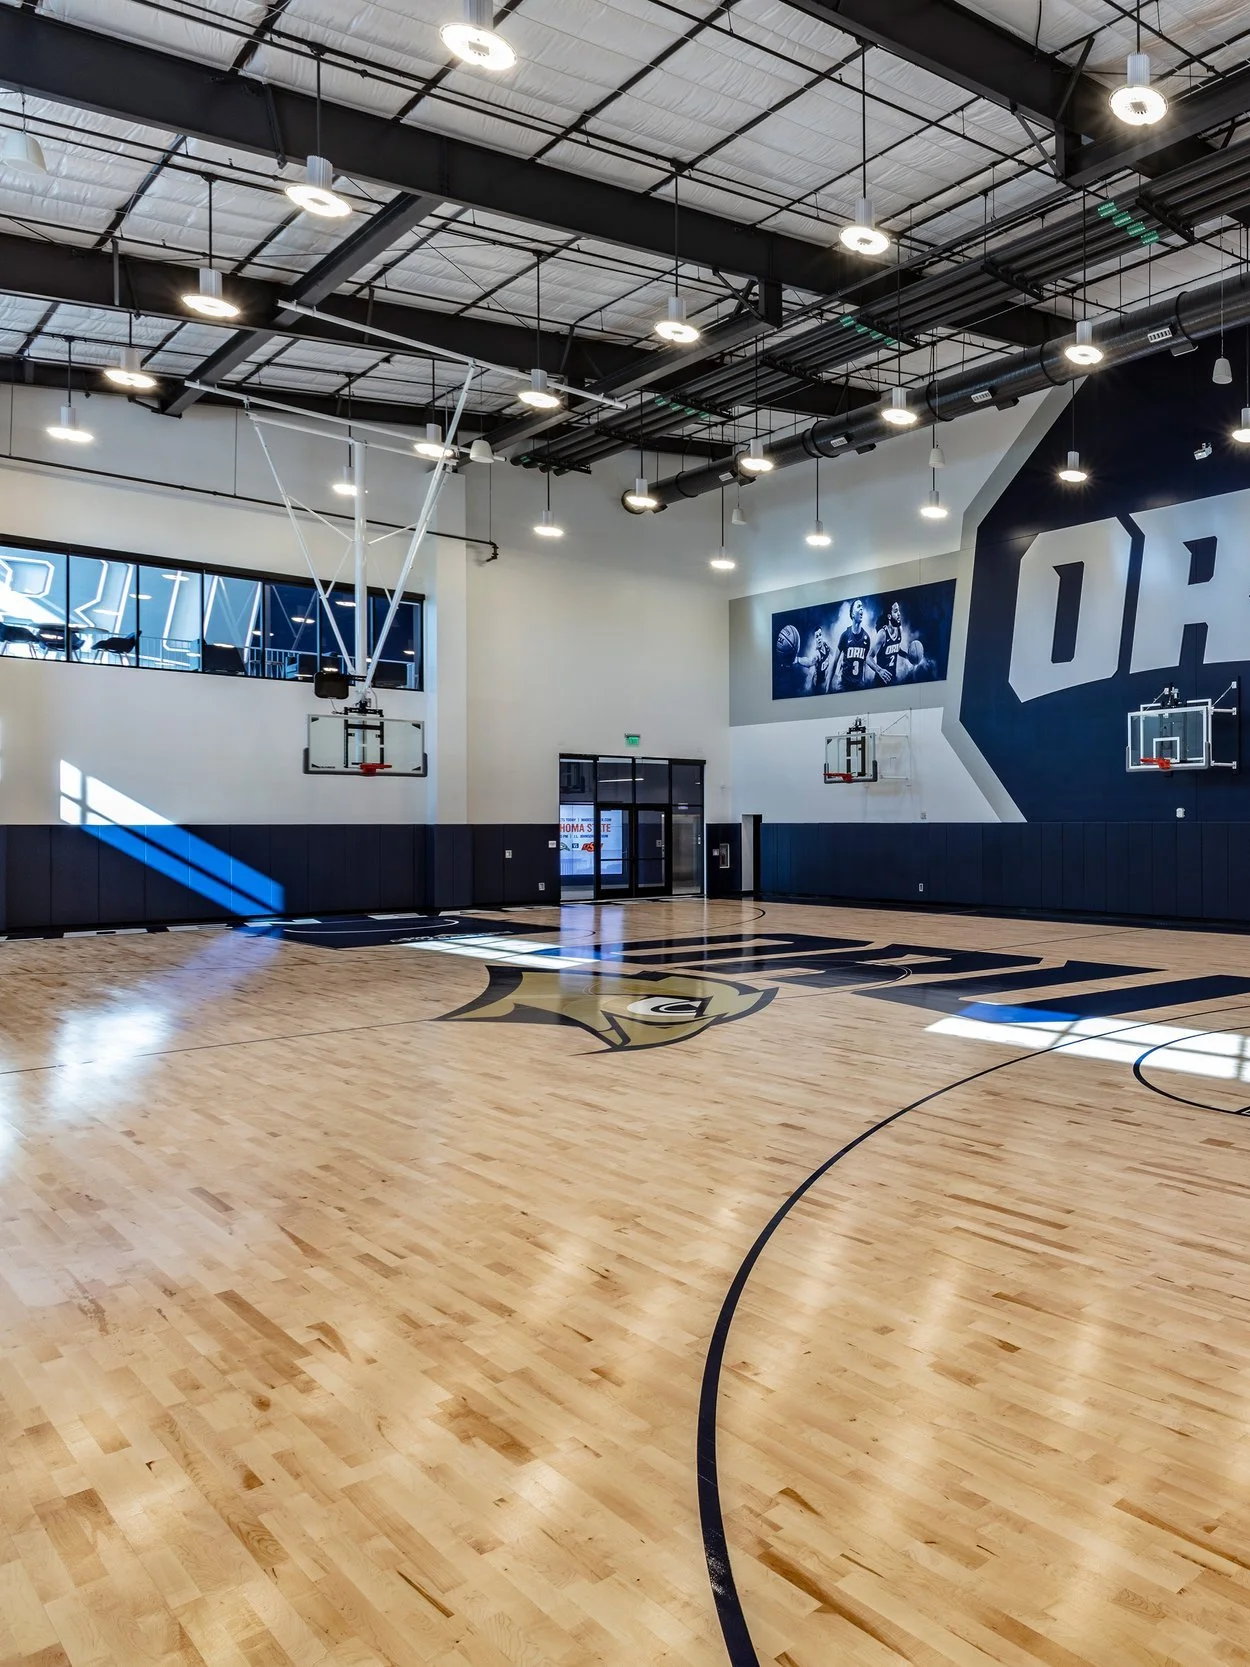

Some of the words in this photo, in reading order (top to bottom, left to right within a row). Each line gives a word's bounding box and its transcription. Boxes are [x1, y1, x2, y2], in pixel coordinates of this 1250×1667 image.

[846, 646, 866, 660] ORU
[852, 660, 859, 676] 3
[889, 655, 895, 667] 2
